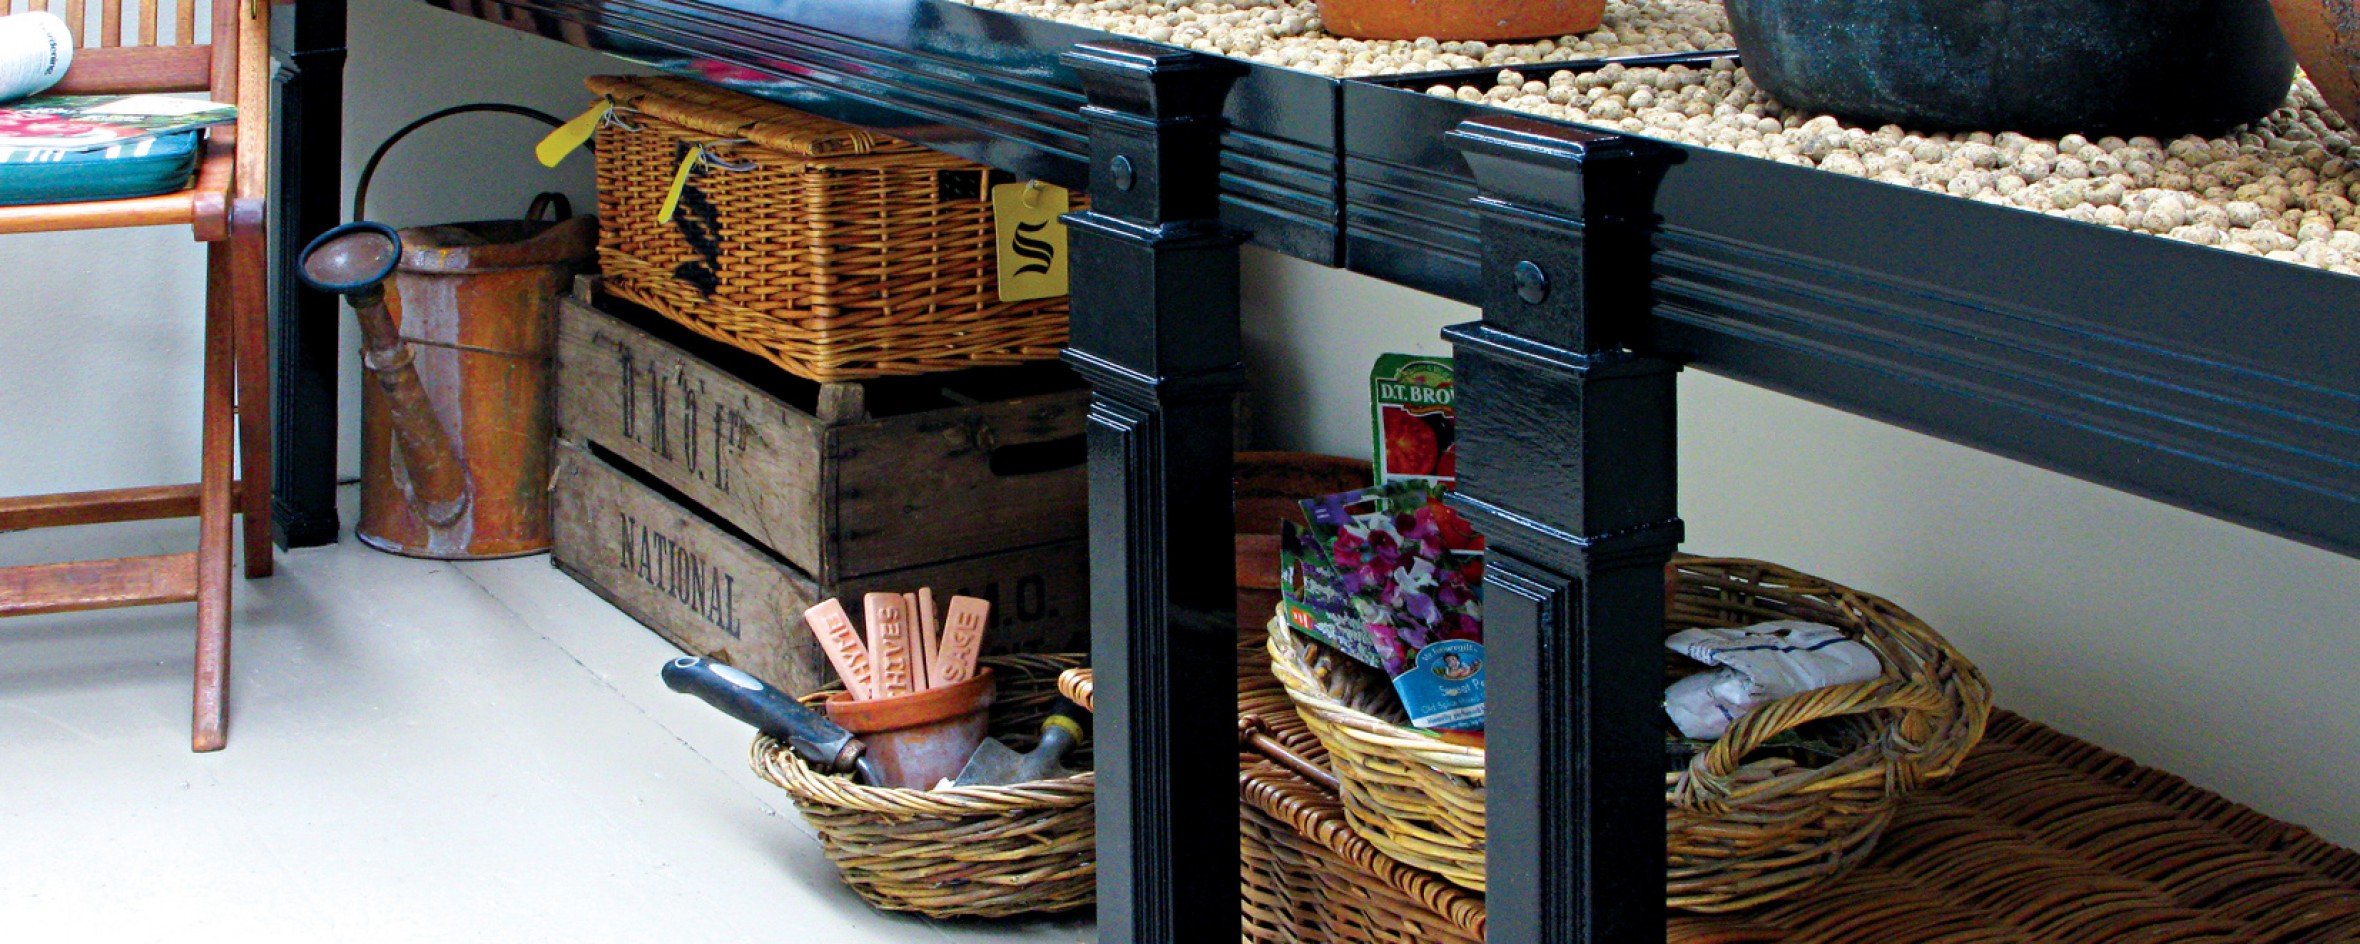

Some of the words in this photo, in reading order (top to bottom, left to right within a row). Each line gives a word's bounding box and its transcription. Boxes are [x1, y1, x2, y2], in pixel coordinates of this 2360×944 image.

[1012, 220, 1054, 277] S
[1410, 386, 1455, 405] BRO
[619, 511, 742, 640] NATIONAL
[822, 612, 872, 700] HYME
[941, 611, 980, 683] SAGE
